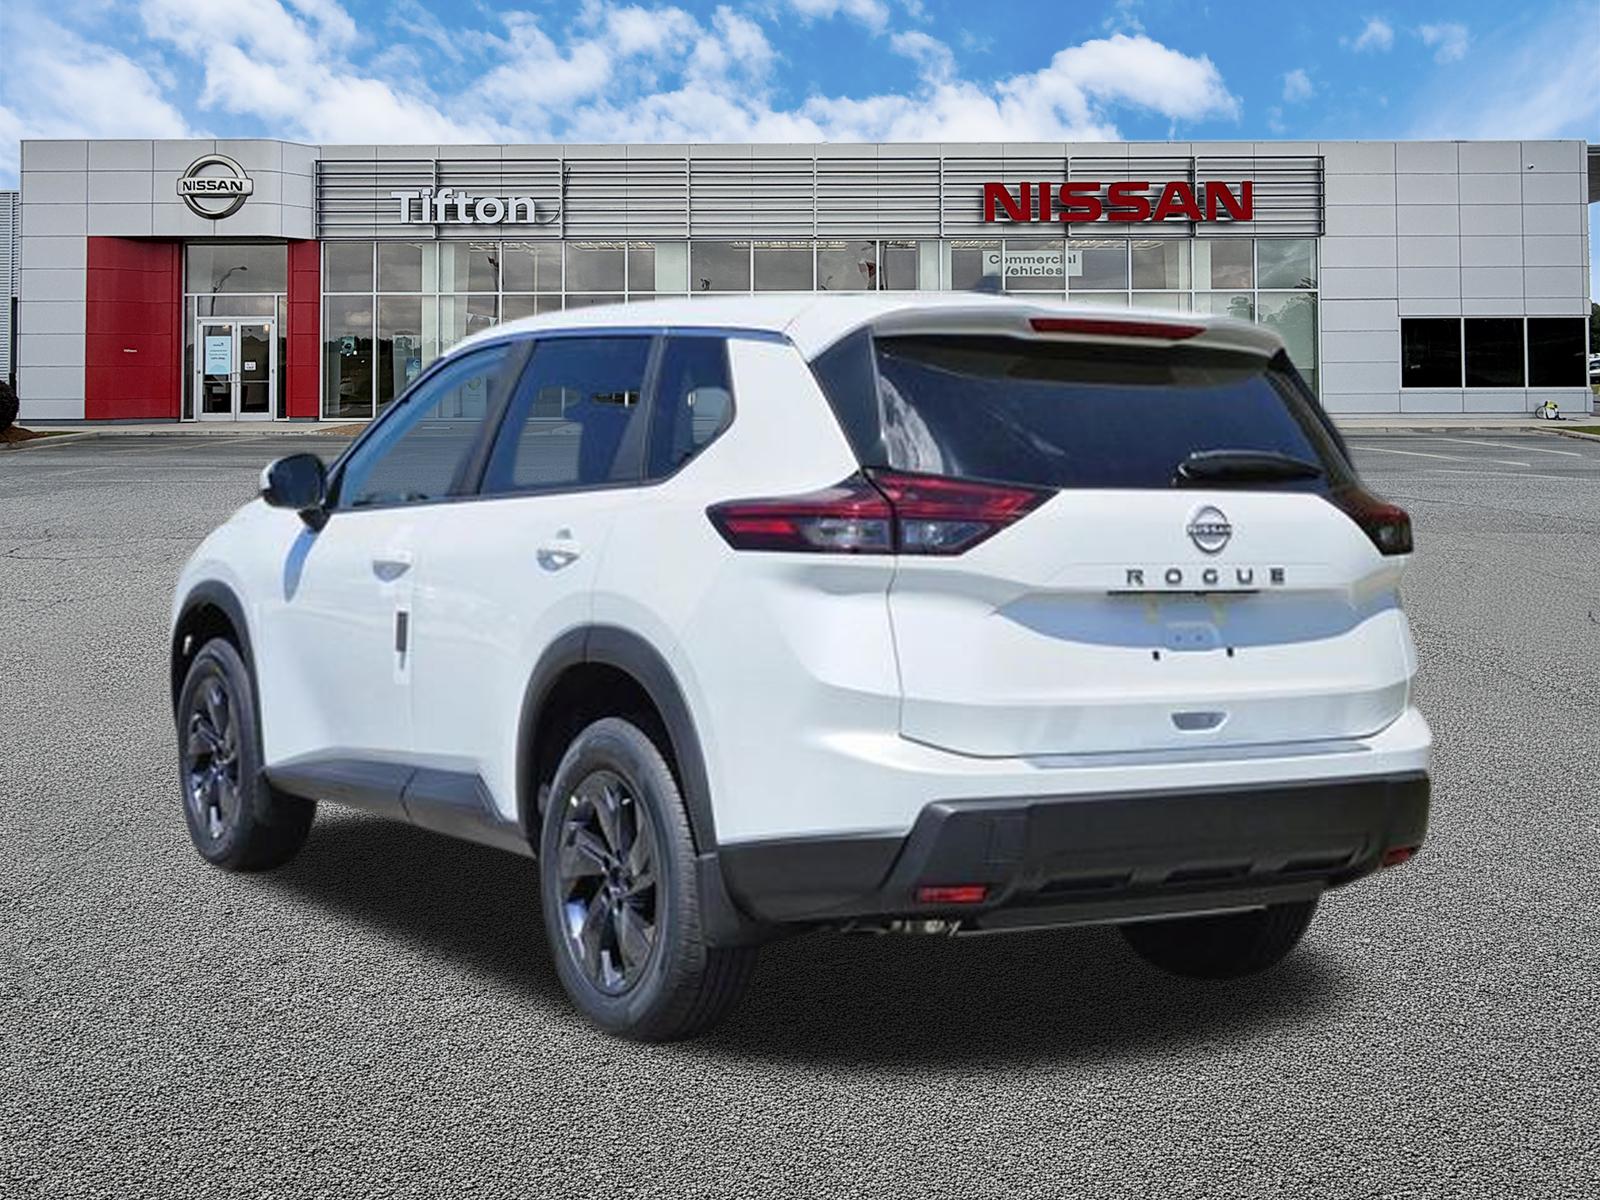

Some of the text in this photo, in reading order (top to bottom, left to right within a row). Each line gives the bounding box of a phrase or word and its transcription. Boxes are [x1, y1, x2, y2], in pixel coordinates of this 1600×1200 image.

[183, 180, 243, 191] NISSAN
[391, 188, 536, 224] Tifton
[984, 181, 1253, 222] NISSAN
[1126, 568, 1285, 585] ROGUE
